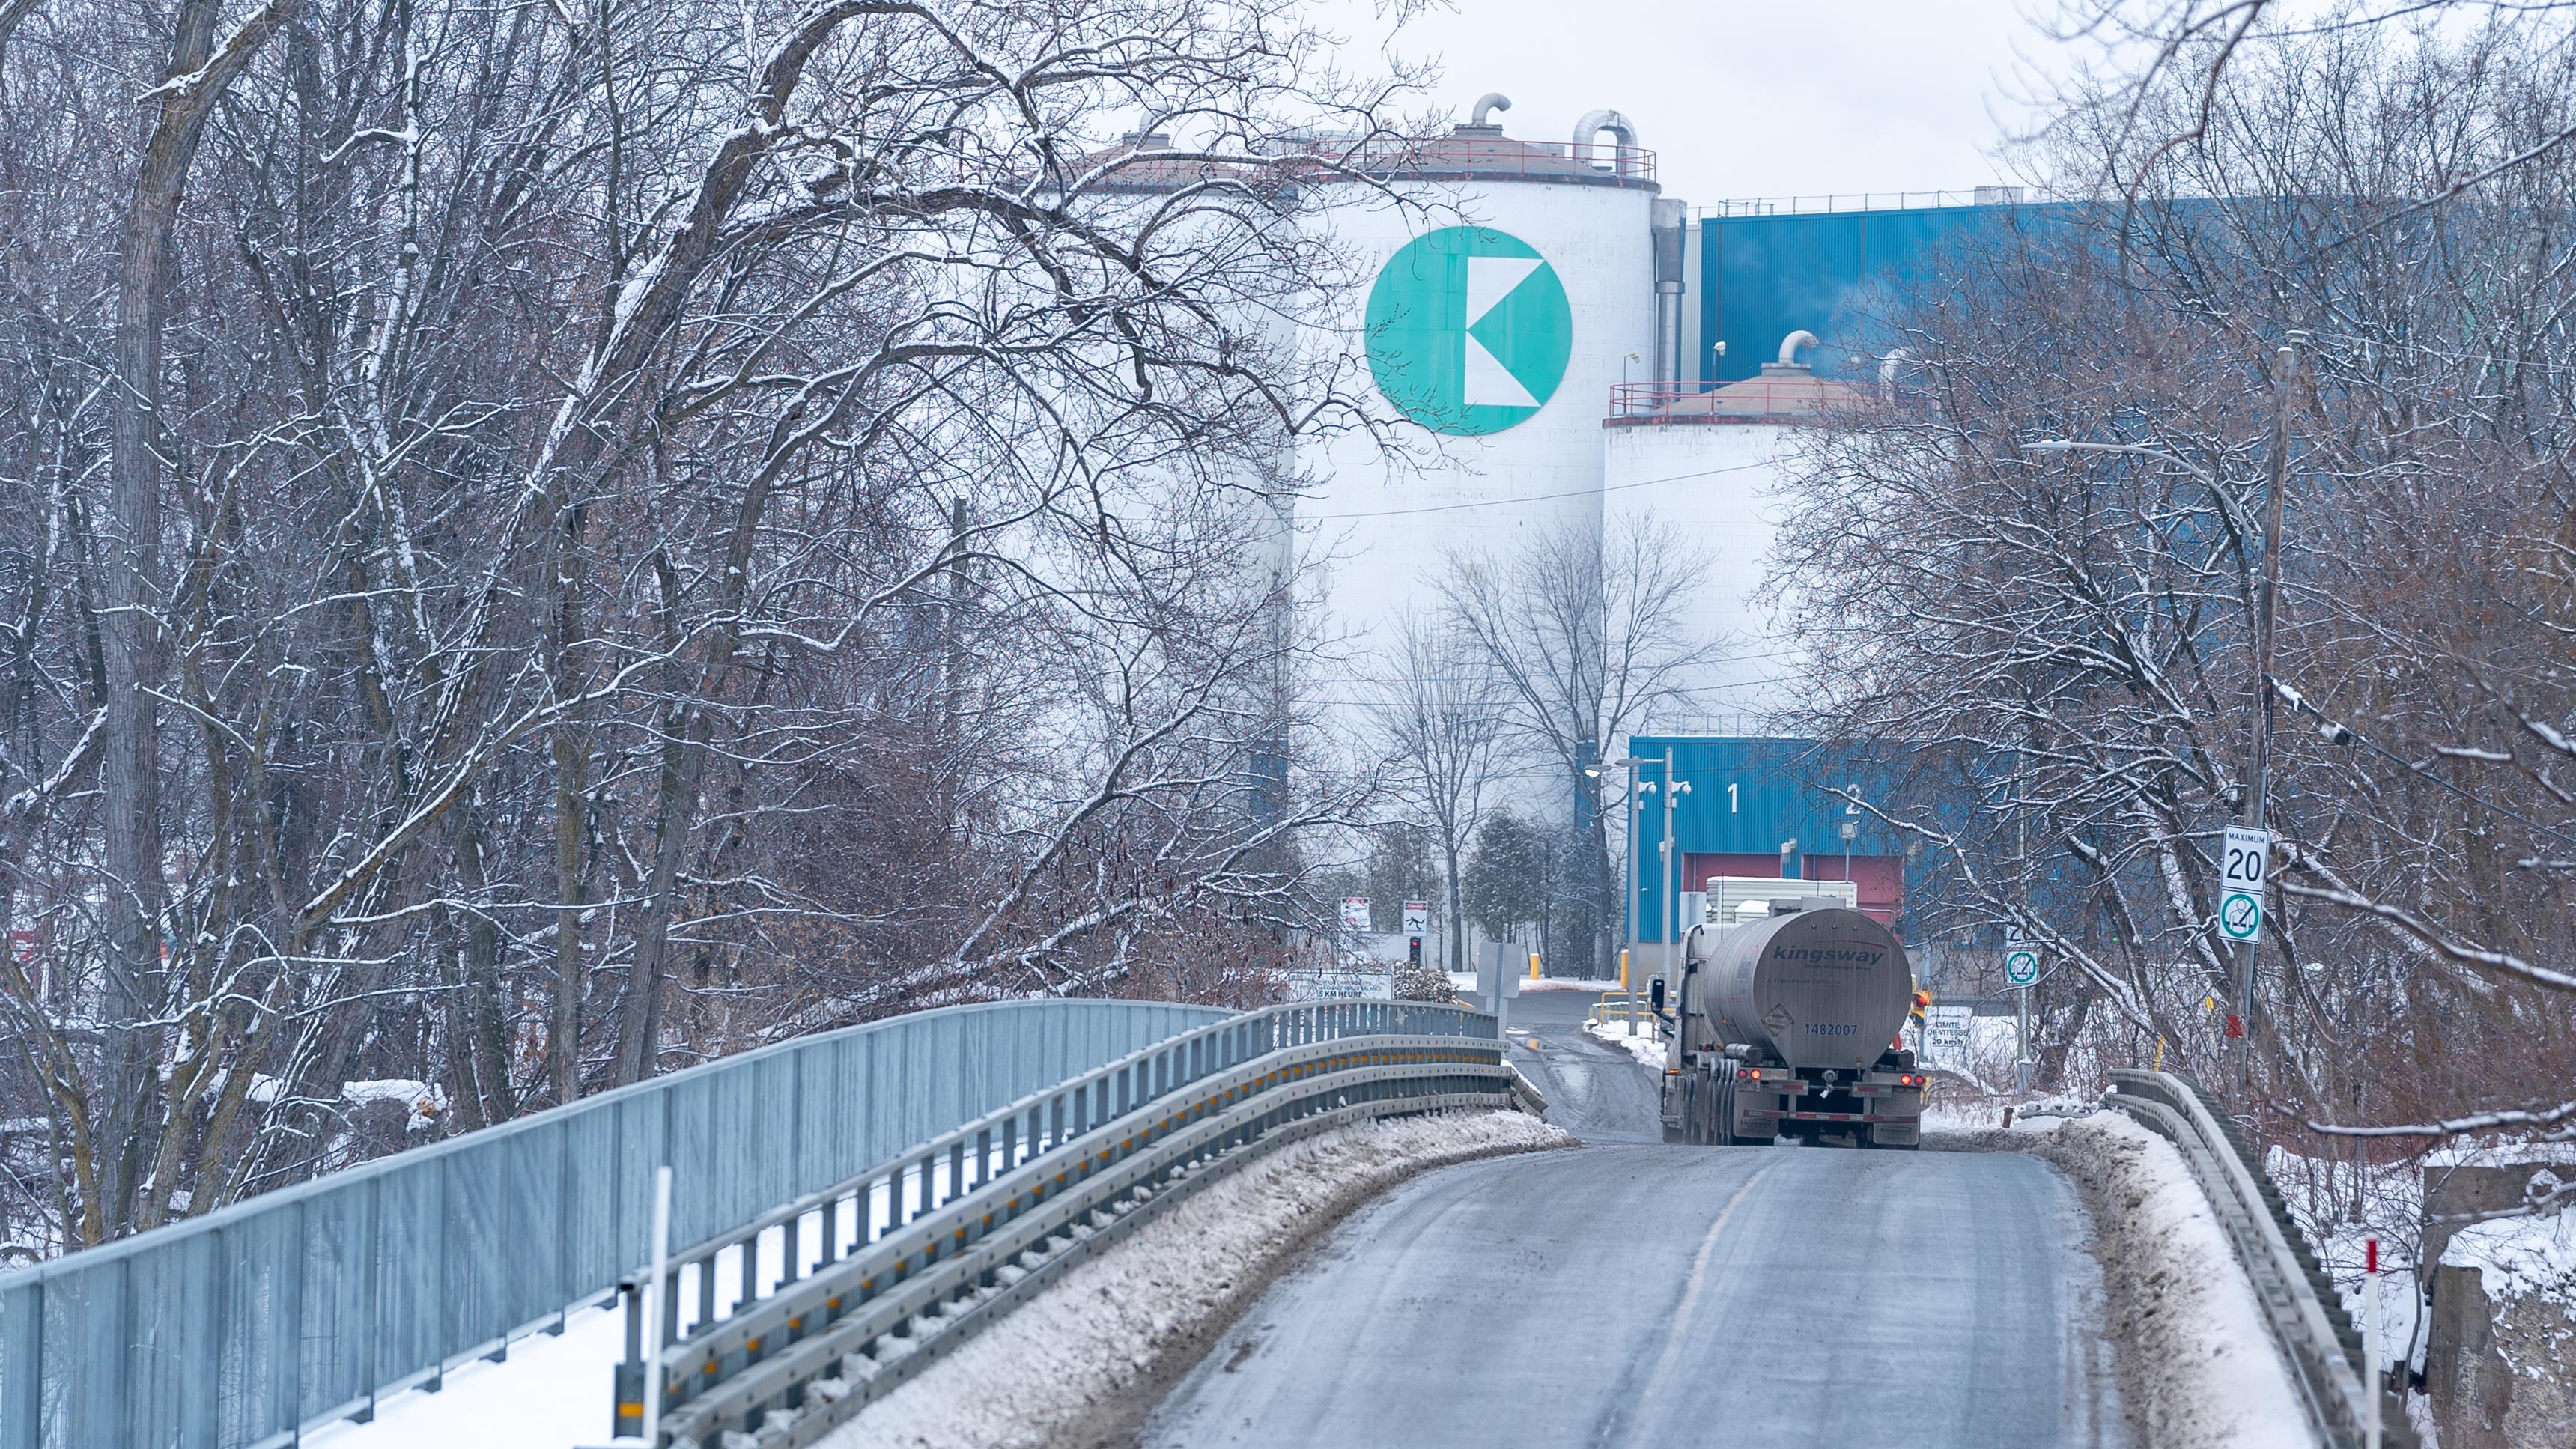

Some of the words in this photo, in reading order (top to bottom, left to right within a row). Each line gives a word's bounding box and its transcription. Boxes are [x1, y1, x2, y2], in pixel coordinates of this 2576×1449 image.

[1728, 783, 1737, 814] 1
[1846, 783, 1861, 815] 2
[2229, 833, 2265, 844] MAXIMUM
[2227, 848, 2261, 882] 20
[1773, 945, 1883, 965] kingsway
[1804, 1024, 1858, 1036] 1482007
